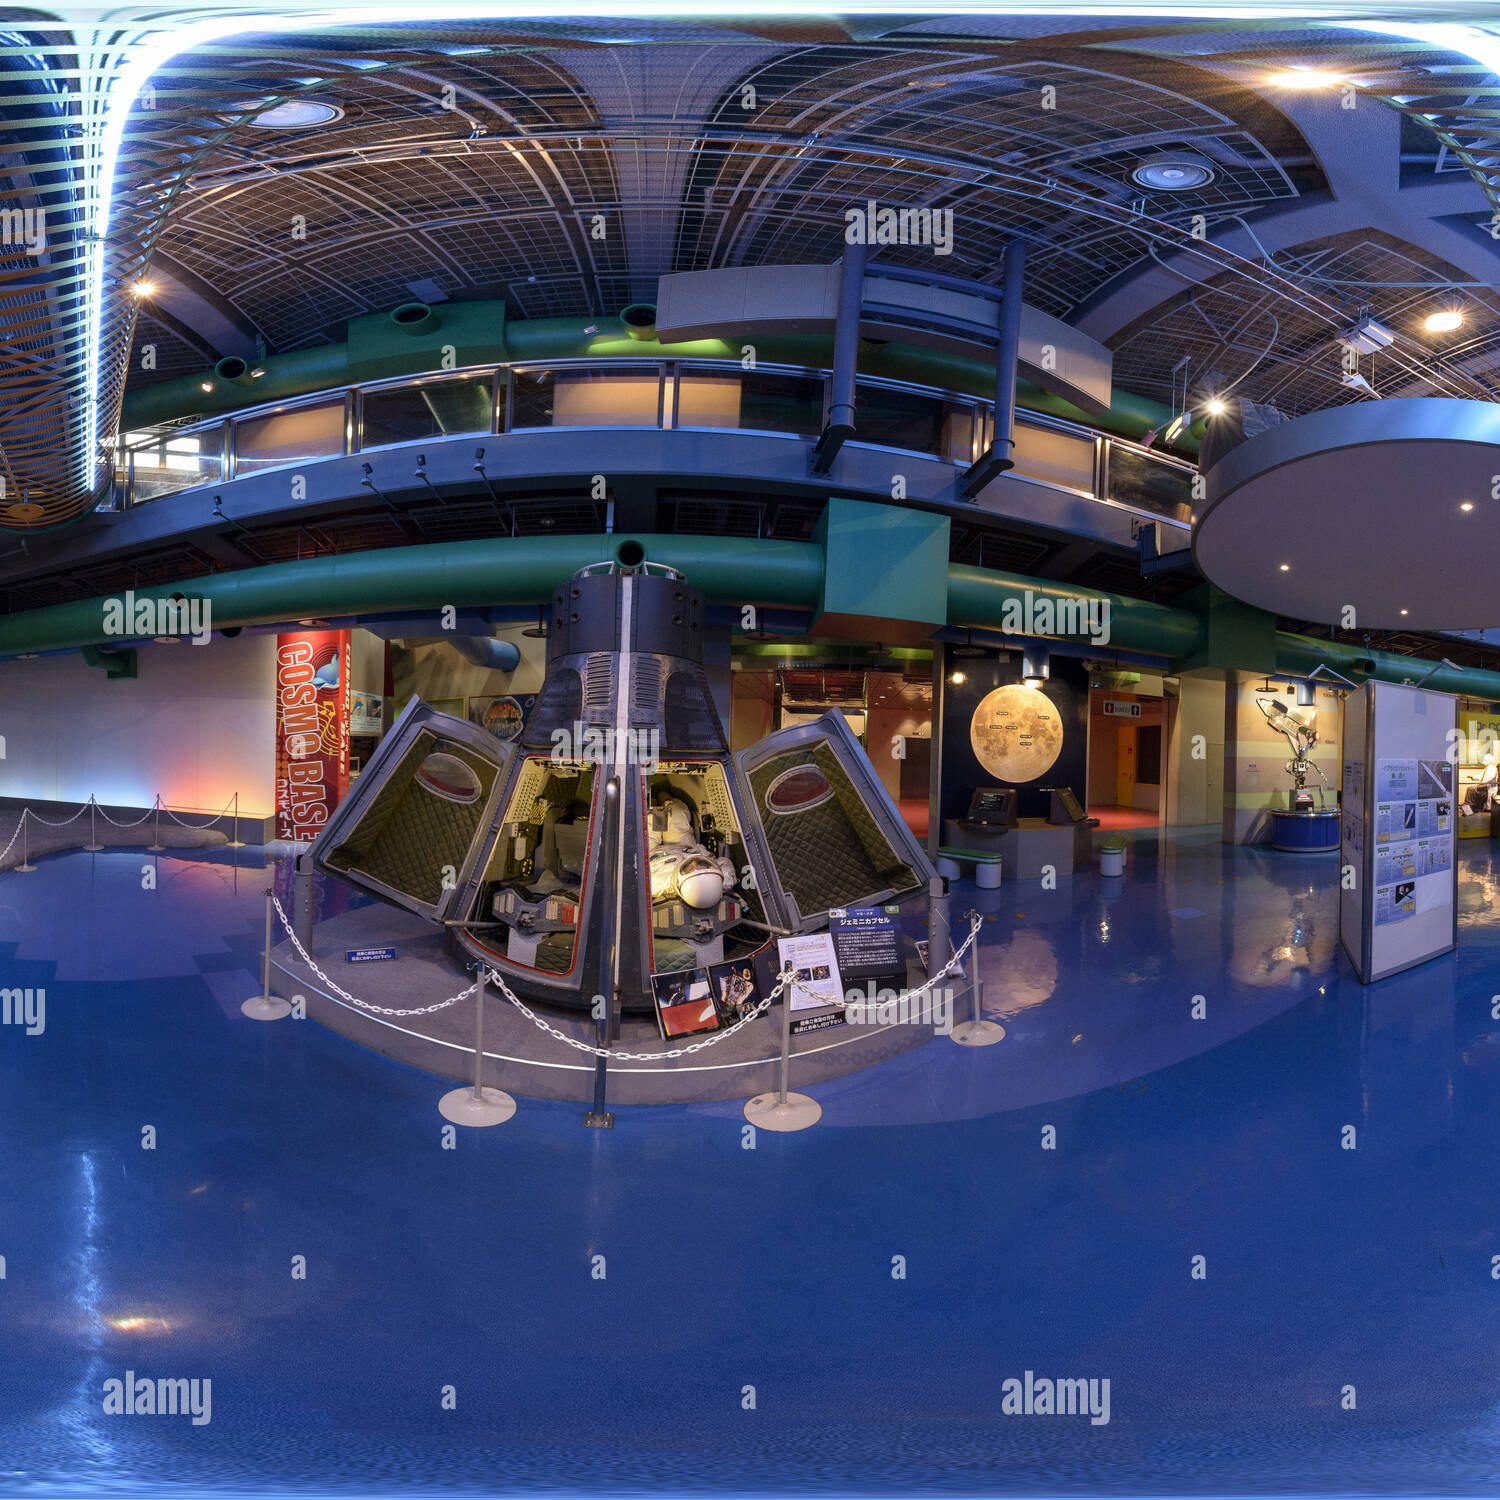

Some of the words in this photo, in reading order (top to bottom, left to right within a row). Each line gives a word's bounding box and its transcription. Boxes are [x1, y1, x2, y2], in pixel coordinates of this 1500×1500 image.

[278, 641, 322, 757] COSMO
[276, 778, 292, 838] コスモベース
[288, 760, 328, 841] BASE
[840, 916, 890, 926] ジェミニカプセル
